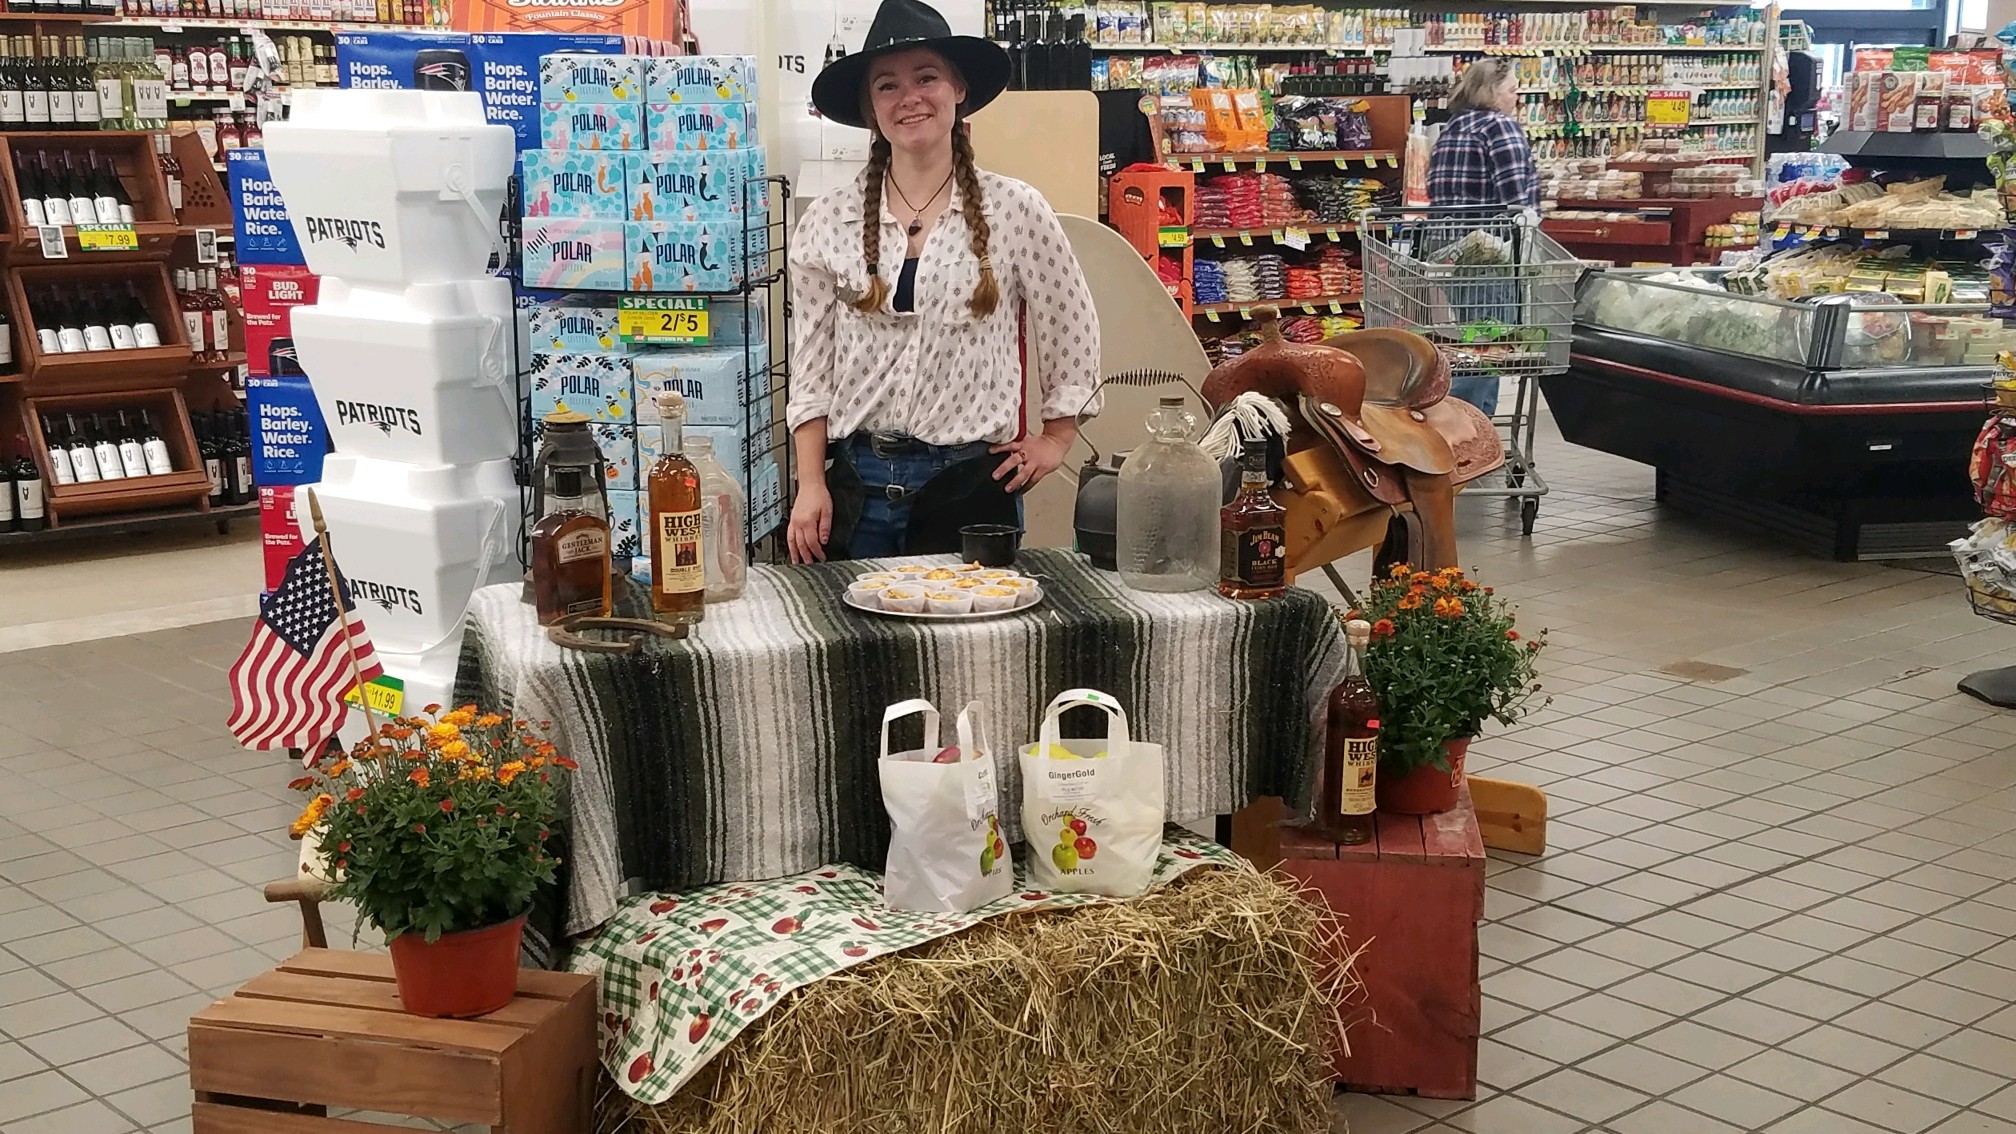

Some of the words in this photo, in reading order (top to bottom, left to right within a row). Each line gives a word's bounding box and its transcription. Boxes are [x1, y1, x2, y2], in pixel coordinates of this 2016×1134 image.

[525, 10, 569, 20] Fountain
[571, 10, 605, 20] Classics
[338, 36, 350, 44] 30
[472, 36, 484, 44] 30
[350, 62, 392, 76] Hops.
[484, 62, 527, 78] Hops.
[572, 67, 607, 86] POLAR
[676, 68, 712, 87] POLAR
[485, 77, 537, 93] Barley.
[486, 93, 536, 106] Water.
[488, 108, 522, 120] Rice.
[572, 114, 606, 132] POLAR
[678, 114, 714, 132] POLAR
[228, 152, 242, 160] 30
[554, 172, 592, 195] POLAR
[656, 174, 696, 196] POLAR
[242, 193, 284, 206] Barle
[246, 222, 282, 235] Rice.
[305, 216, 386, 249] PATRIOTS
[552, 240, 592, 263] POLAR
[656, 244, 696, 265] POLAR
[242, 267, 256, 275] 30
[272, 282, 298, 290] BUD
[268, 290, 304, 300] LIGHT
[623, 298, 704, 310] SPECIAL!
[560, 317, 594, 336] POLAR
[661, 313, 698, 332] 2/$5
[248, 379, 260, 387] 30
[561, 376, 600, 398] POLAR
[260, 404, 302, 419] Hops.
[336, 400, 422, 436] PATRIOTS
[261, 418, 312, 432] Barley.
[262, 432, 312, 444] Water.
[263, 446, 299, 458] Rice.
[664, 526, 702, 536] WEST
[562, 537, 602, 550] GENTLEMAN
[574, 546, 591, 554] JACK
[349, 579, 422, 615] ATRIOTS
[1348, 740, 1376, 752] HIG
[1348, 752, 1376, 760] WES
[1048, 768, 1095, 780] GingerGold
[1041, 805, 1078, 826] Orchard
[1075, 808, 1108, 826] Fresh
